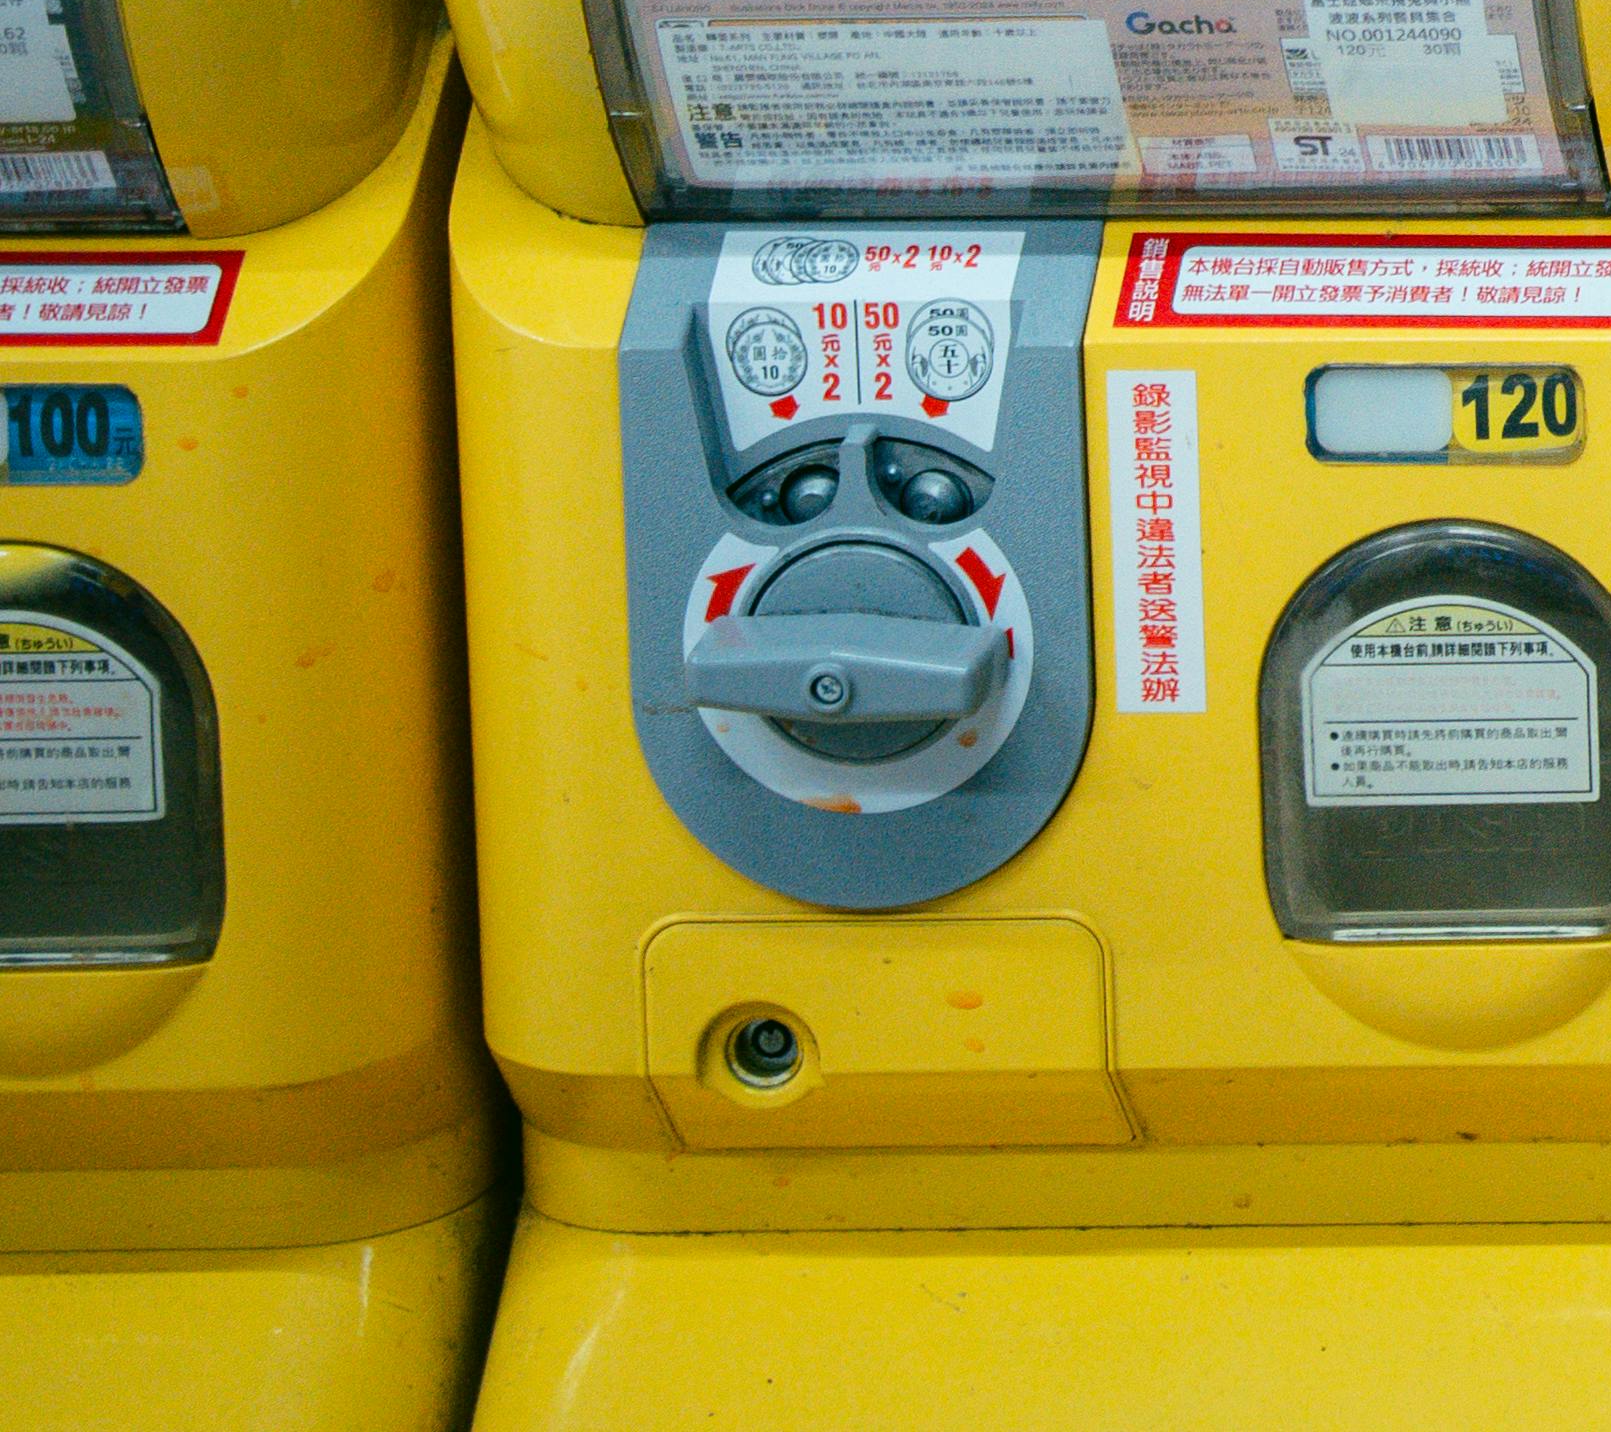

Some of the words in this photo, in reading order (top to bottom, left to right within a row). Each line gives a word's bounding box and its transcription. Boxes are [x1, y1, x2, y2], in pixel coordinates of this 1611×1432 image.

[1125, 11, 1234, 35] Gacha
[1325, 26, 1463, 44] NO.001244090
[1460, 372, 1578, 440] 120
